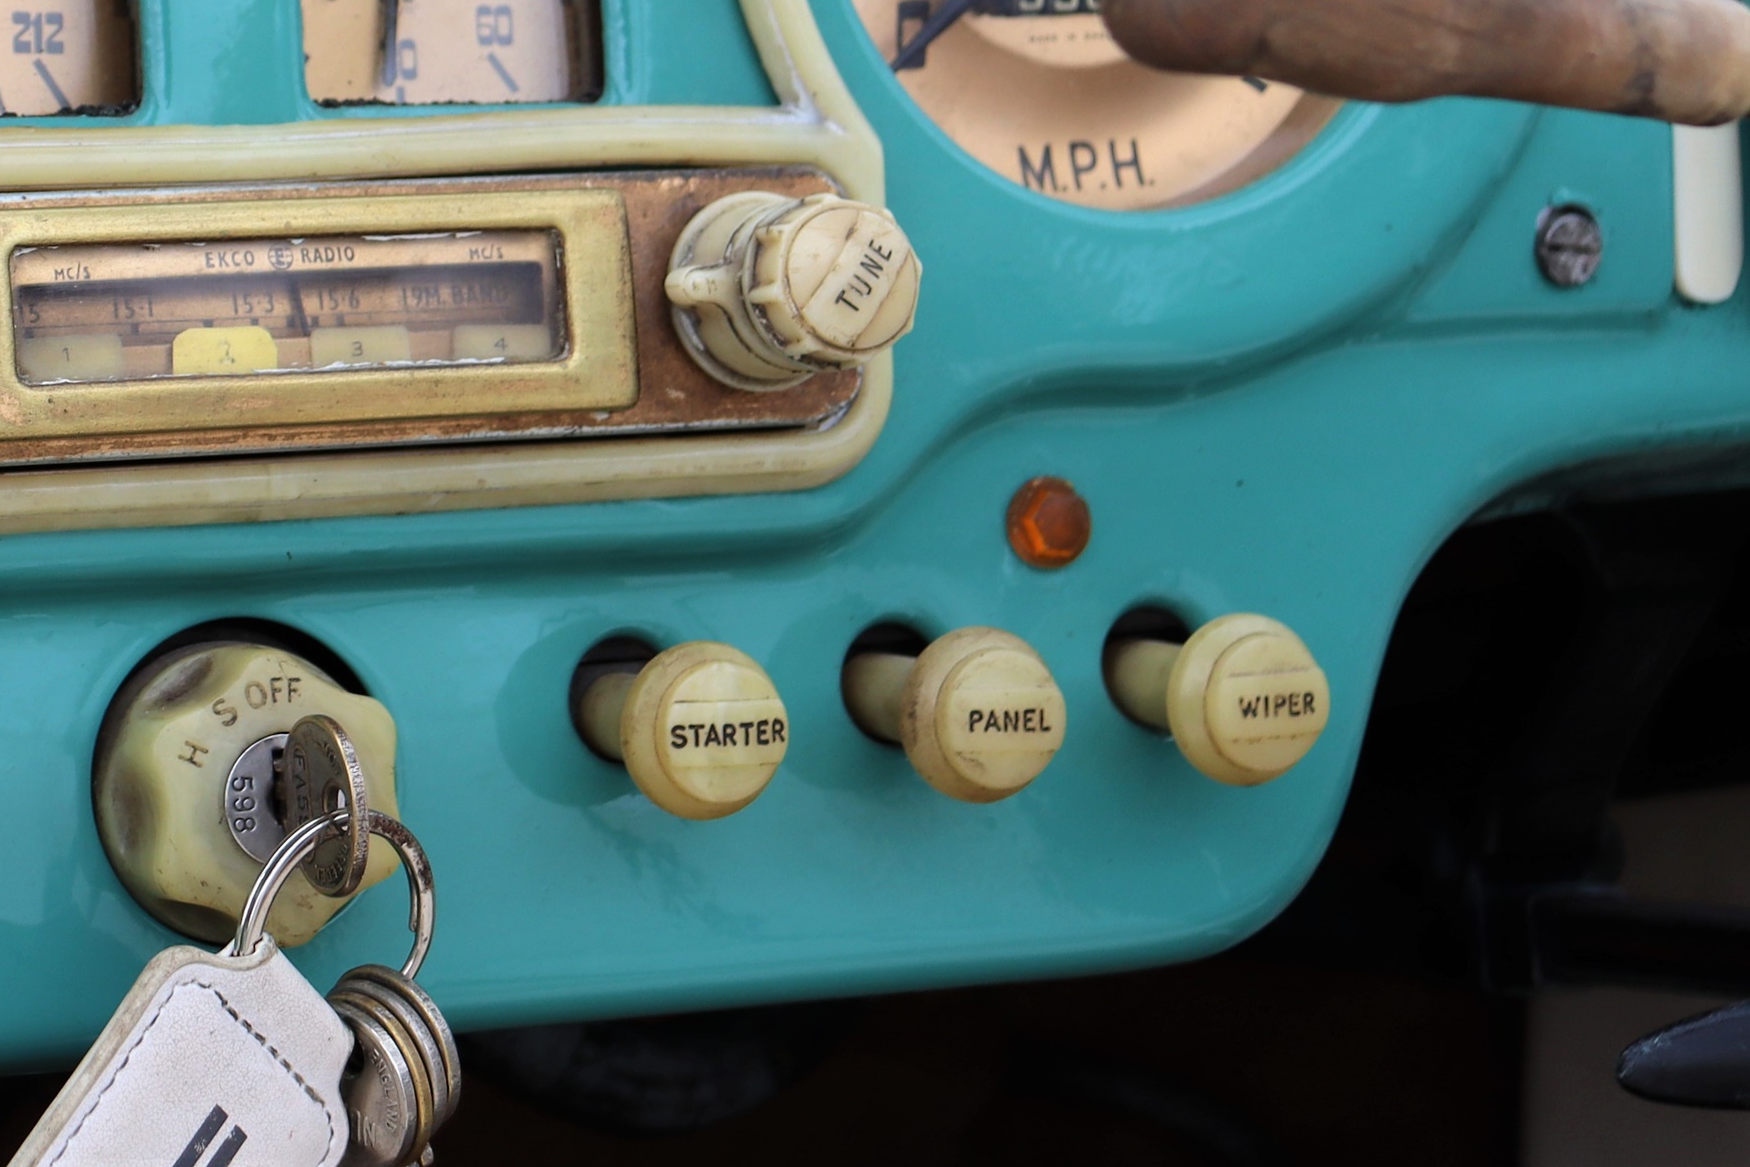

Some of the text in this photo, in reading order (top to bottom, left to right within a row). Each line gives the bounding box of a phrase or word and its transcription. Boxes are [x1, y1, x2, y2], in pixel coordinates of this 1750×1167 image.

[11, 11, 64, 54] 212
[476, 5, 513, 46] 60
[1018, 138, 1155, 192] M.P.H.
[205, 250, 255, 269] EKCO
[301, 246, 355, 264] RADIO
[835, 239, 893, 312] TUNE
[62, 346, 71, 362] 1
[351, 340, 364, 357] 3
[494, 335, 509, 352] 4
[178, 676, 302, 769] H S OFF
[967, 708, 1052, 734] PANEL
[1238, 692, 1317, 719] WIPER
[670, 718, 786, 750] STARTER
[232, 776, 258, 834] 598
[371, 1048, 397, 1134] ENGLAND
